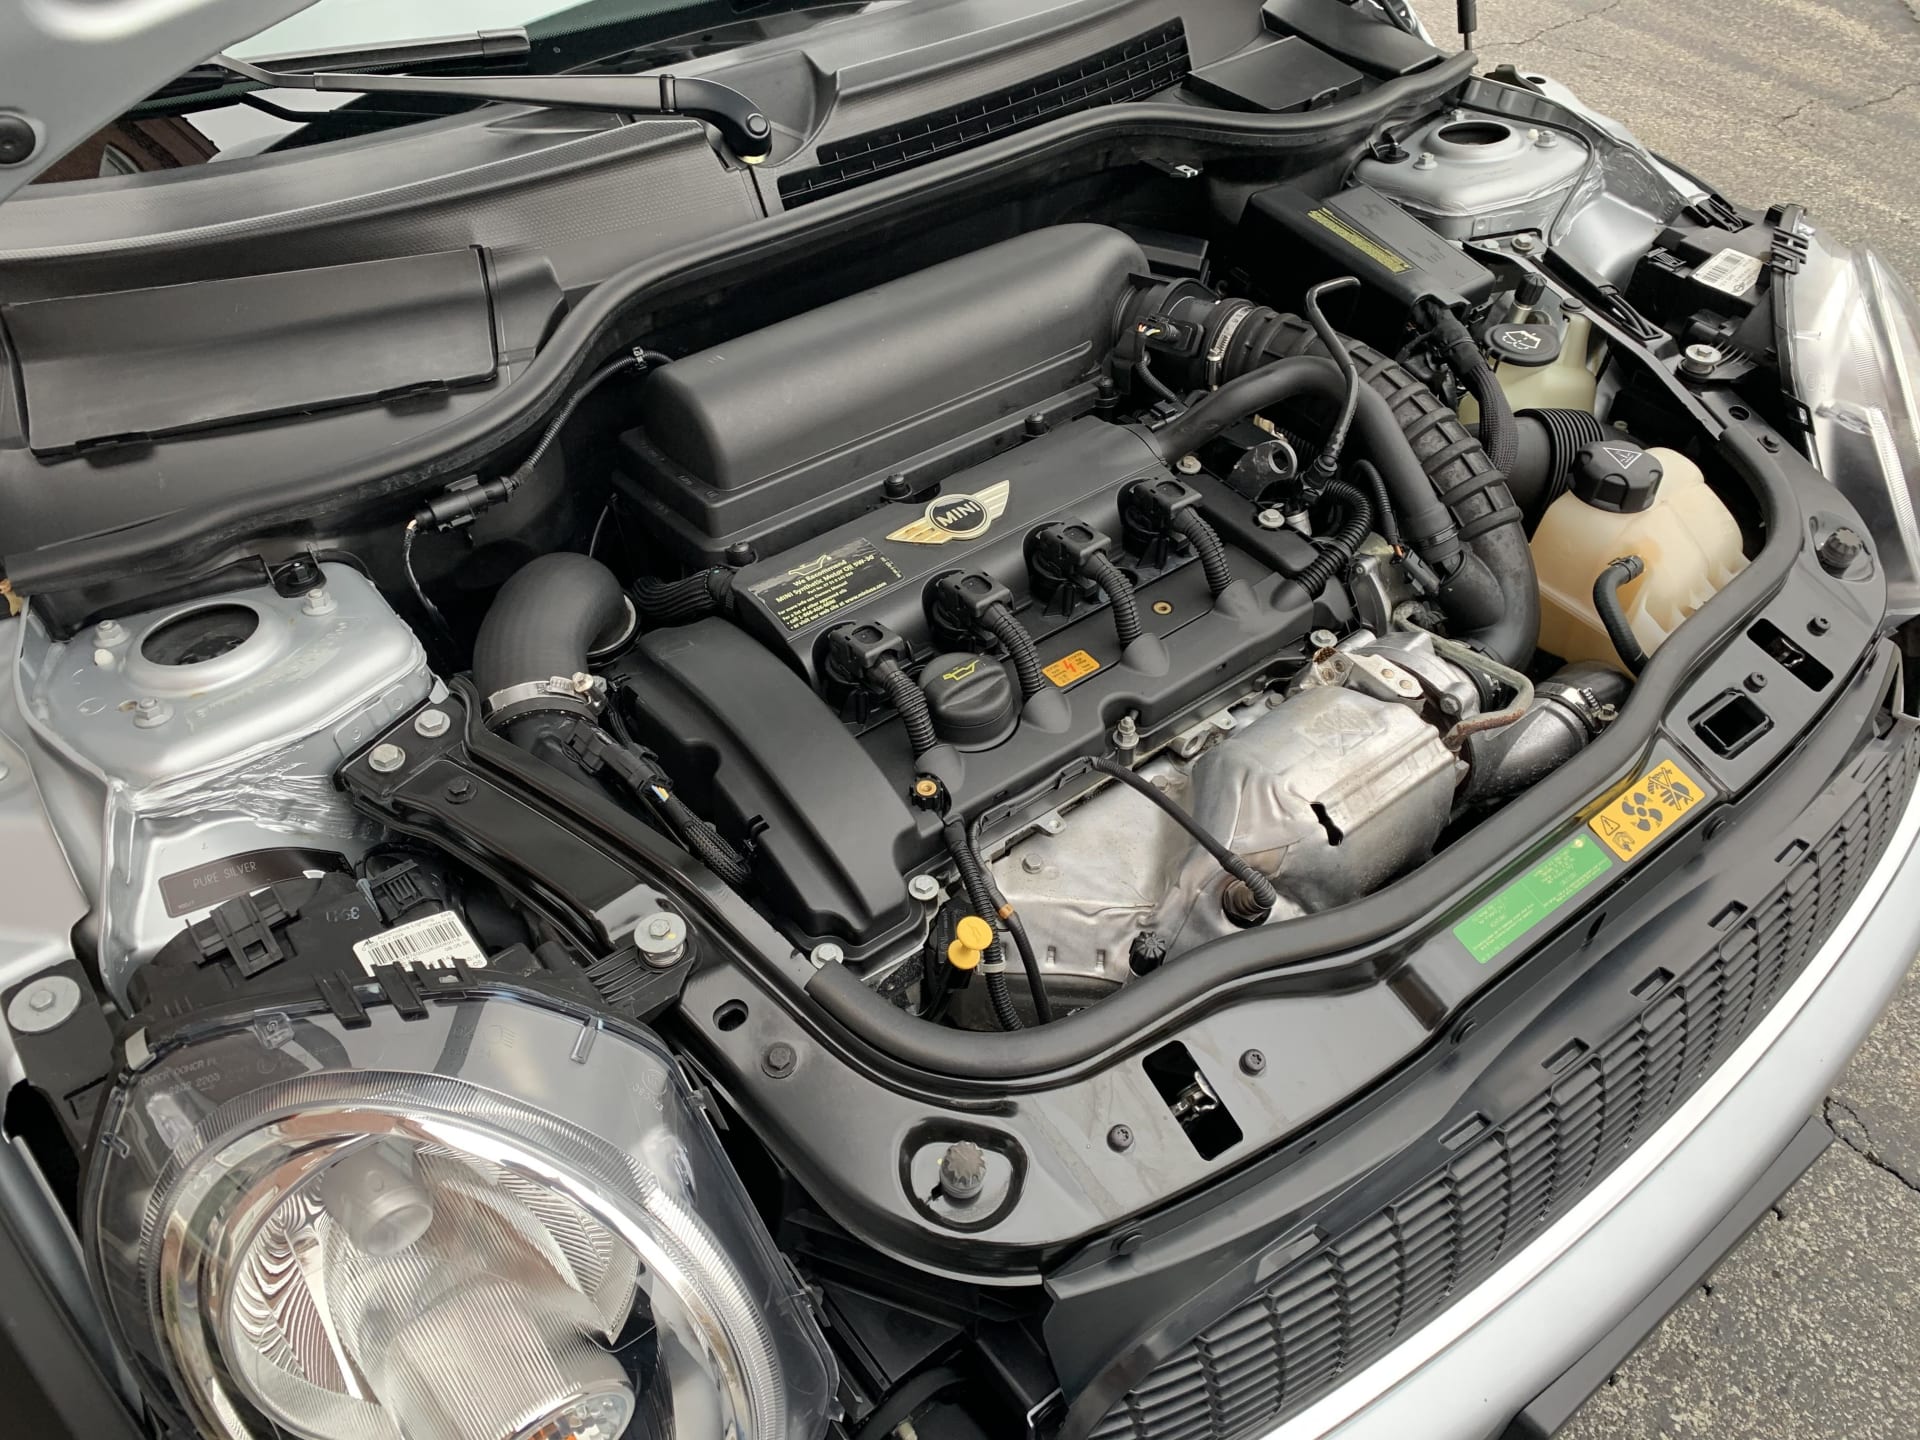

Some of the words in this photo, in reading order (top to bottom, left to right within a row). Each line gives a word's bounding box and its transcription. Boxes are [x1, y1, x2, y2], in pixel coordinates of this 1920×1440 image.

[936, 501, 981, 527] MINI
[776, 592, 794, 603] MINI
[792, 578, 823, 595] Synthetic
[823, 569, 843, 582] Motor
[843, 564, 854, 572] Oil
[805, 560, 847, 580] Recommend
[193, 873, 219, 889] PURE
[224, 861, 257, 879] SILVER
